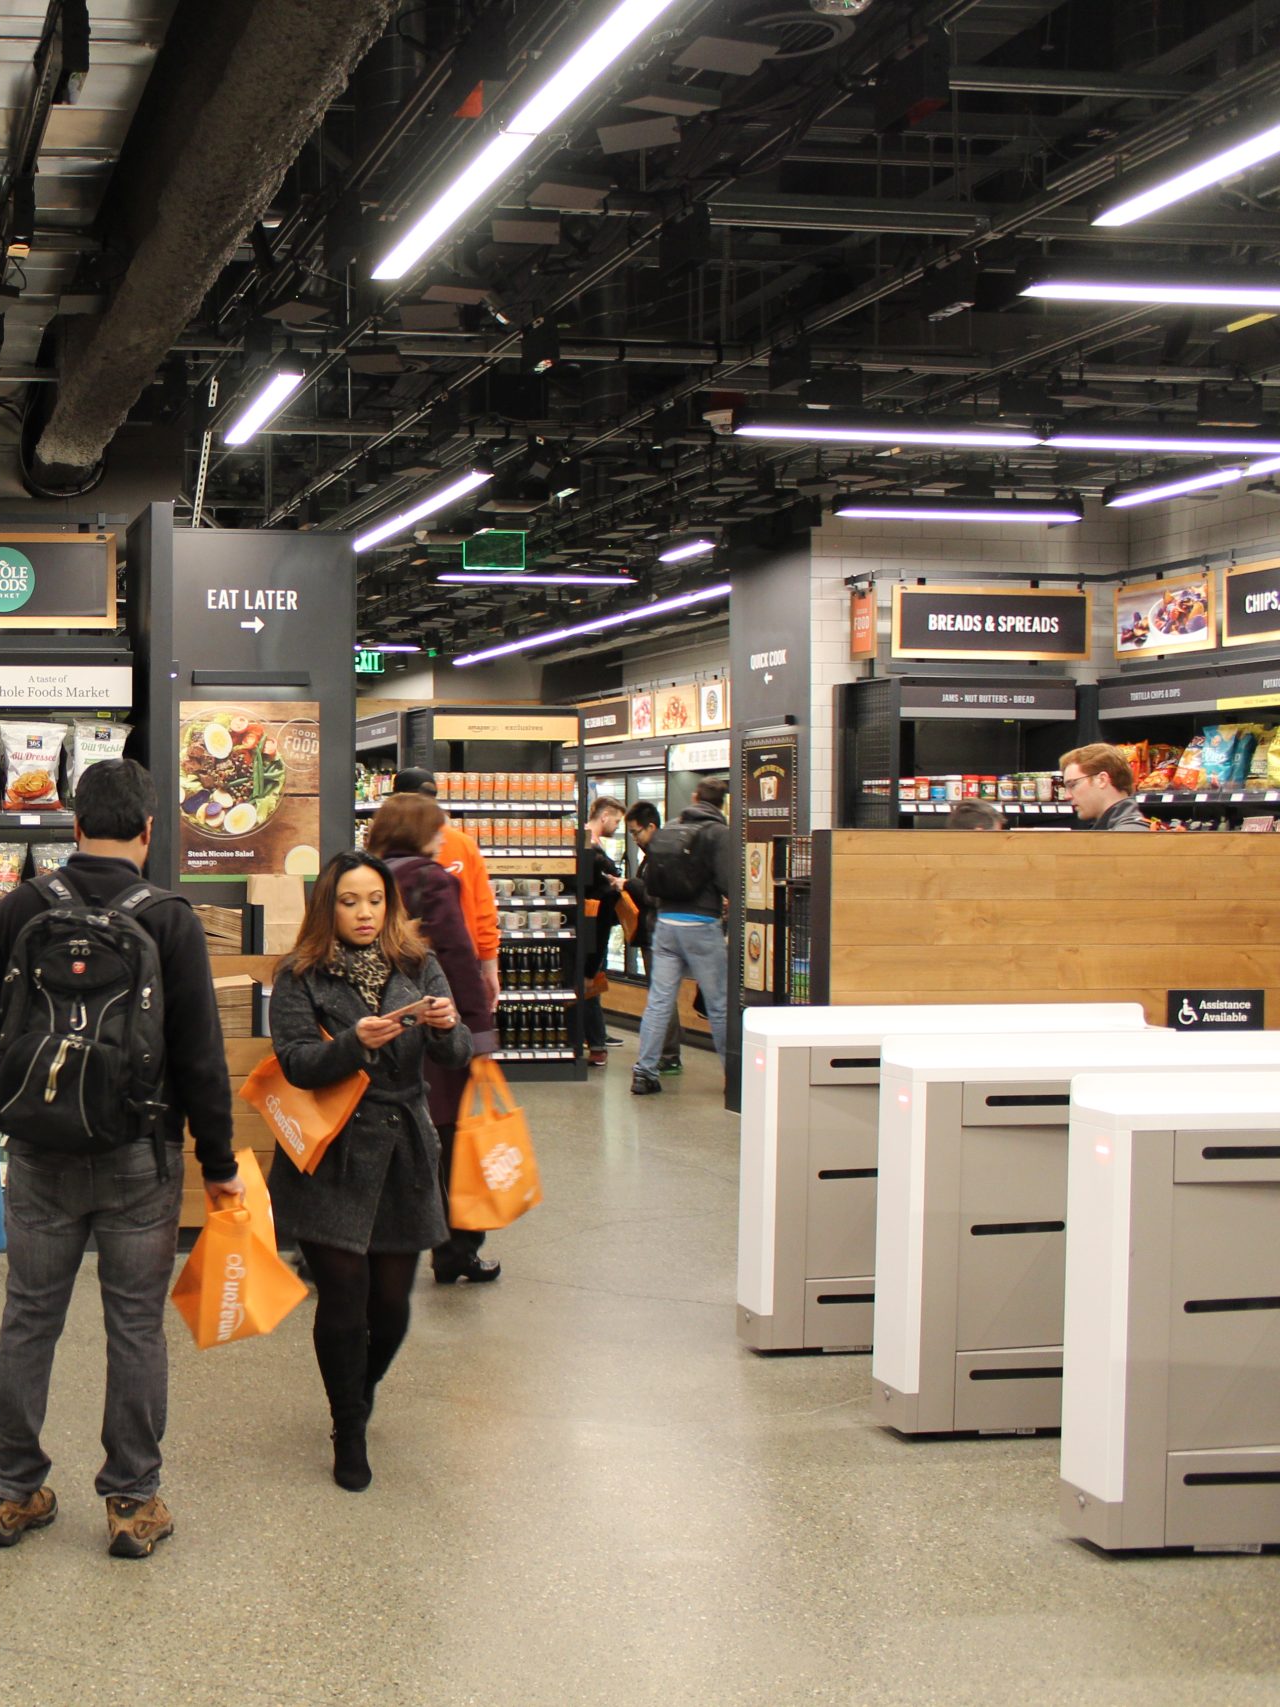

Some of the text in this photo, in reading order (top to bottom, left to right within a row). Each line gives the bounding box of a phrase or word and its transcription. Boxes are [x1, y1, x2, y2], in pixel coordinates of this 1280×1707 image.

[207, 589, 298, 610] EAT LATER
[928, 614, 1060, 633] BREADS & SPREADS
[36, 675, 57, 683] taste
[58, 675, 68, 683] of
[28, 686, 63, 698] Foods
[65, 686, 110, 698] Market
[1130, 691, 1150, 701] TORTILLA
[1150, 689, 1165, 699] CHIPS
[1169, 688, 1181, 698] DIPS
[942, 694, 1035, 704] JAMS NUT BUTTERS BREAD
[292, 729, 317, 738] GOOD
[81, 742, 96, 751] Dill
[283, 736, 319, 754] FOOD
[1199, 1000, 1252, 1009] Assistance
[1202, 1012, 1248, 1022] Available
[273, 1108, 305, 1155] amazon
[217, 1281, 246, 1341] amazon
